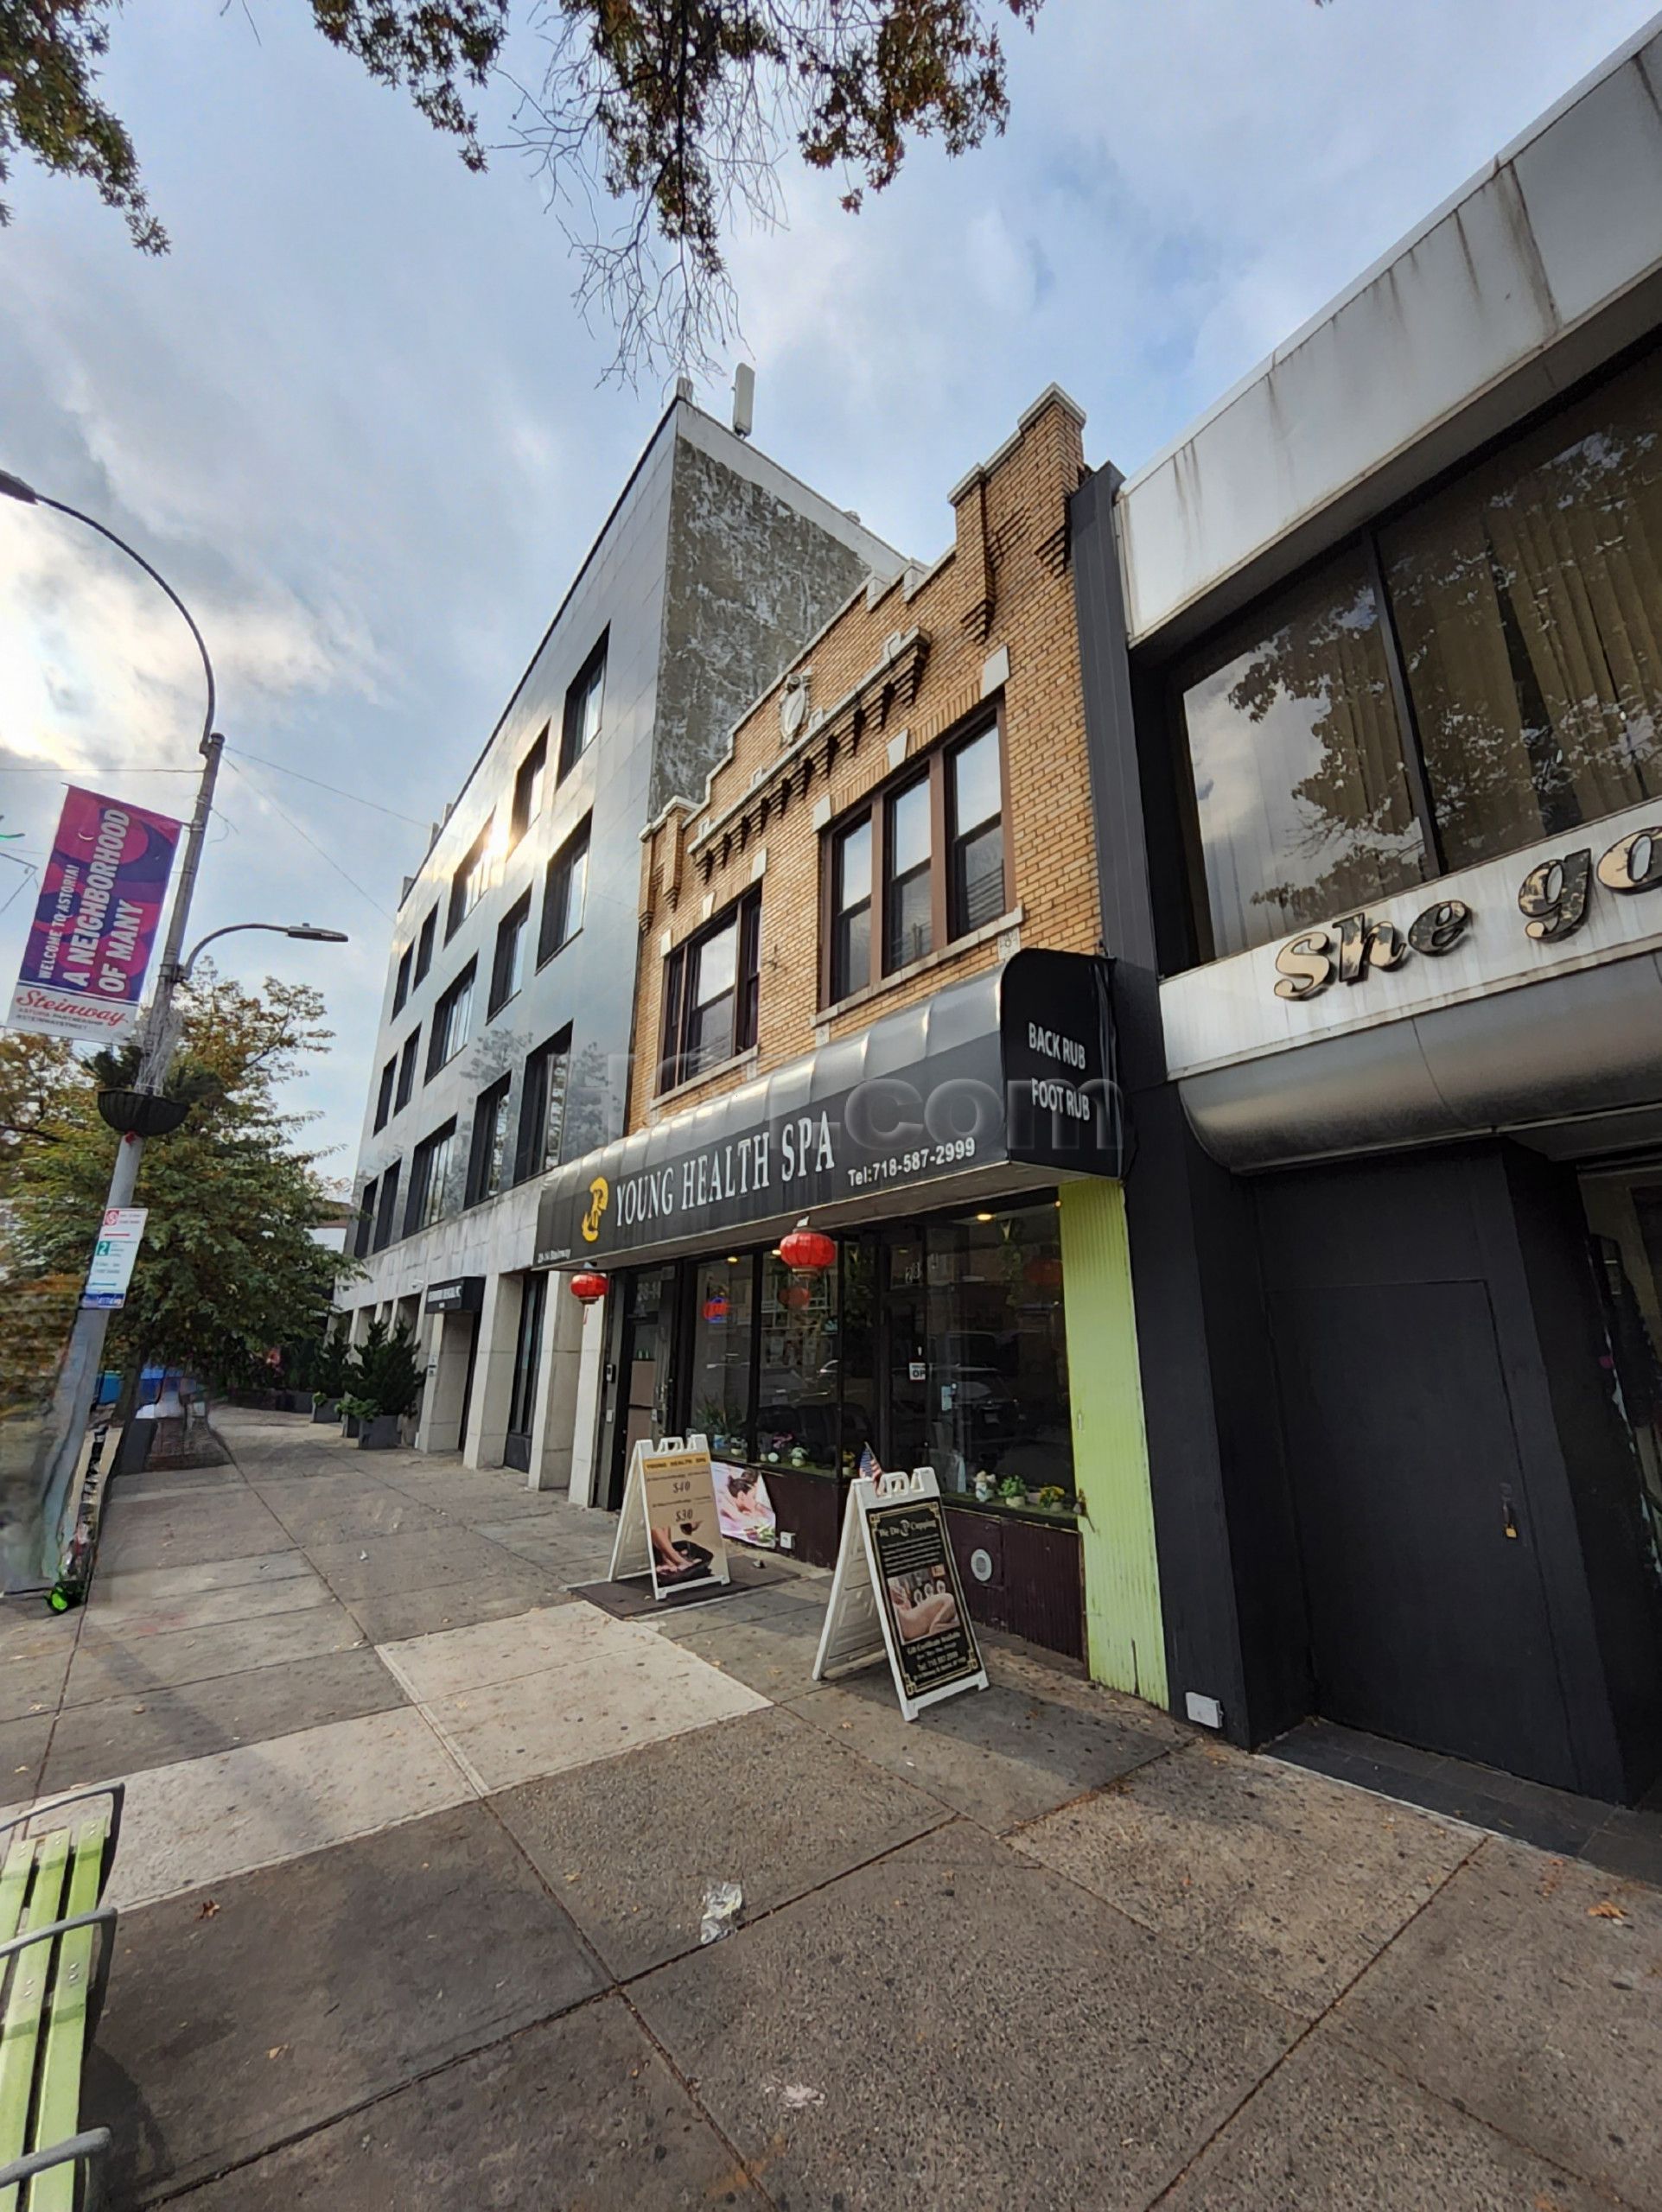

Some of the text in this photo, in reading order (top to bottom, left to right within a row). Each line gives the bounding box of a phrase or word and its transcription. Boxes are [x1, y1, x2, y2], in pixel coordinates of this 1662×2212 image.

[38, 864, 80, 979] WELCOME TO ASTORIA!
[62, 809, 130, 988] A NEIGHBORHOOD
[98, 899, 144, 993] OF MANY
[1274, 899, 1469, 1001] She
[16, 990, 129, 1027] Steinway
[1028, 1021, 1086, 1070] BACK RUB
[1031, 1077, 1091, 1122] FOOT RUB
[616, 1110, 835, 1227] YOUNG HEALTH SPA
